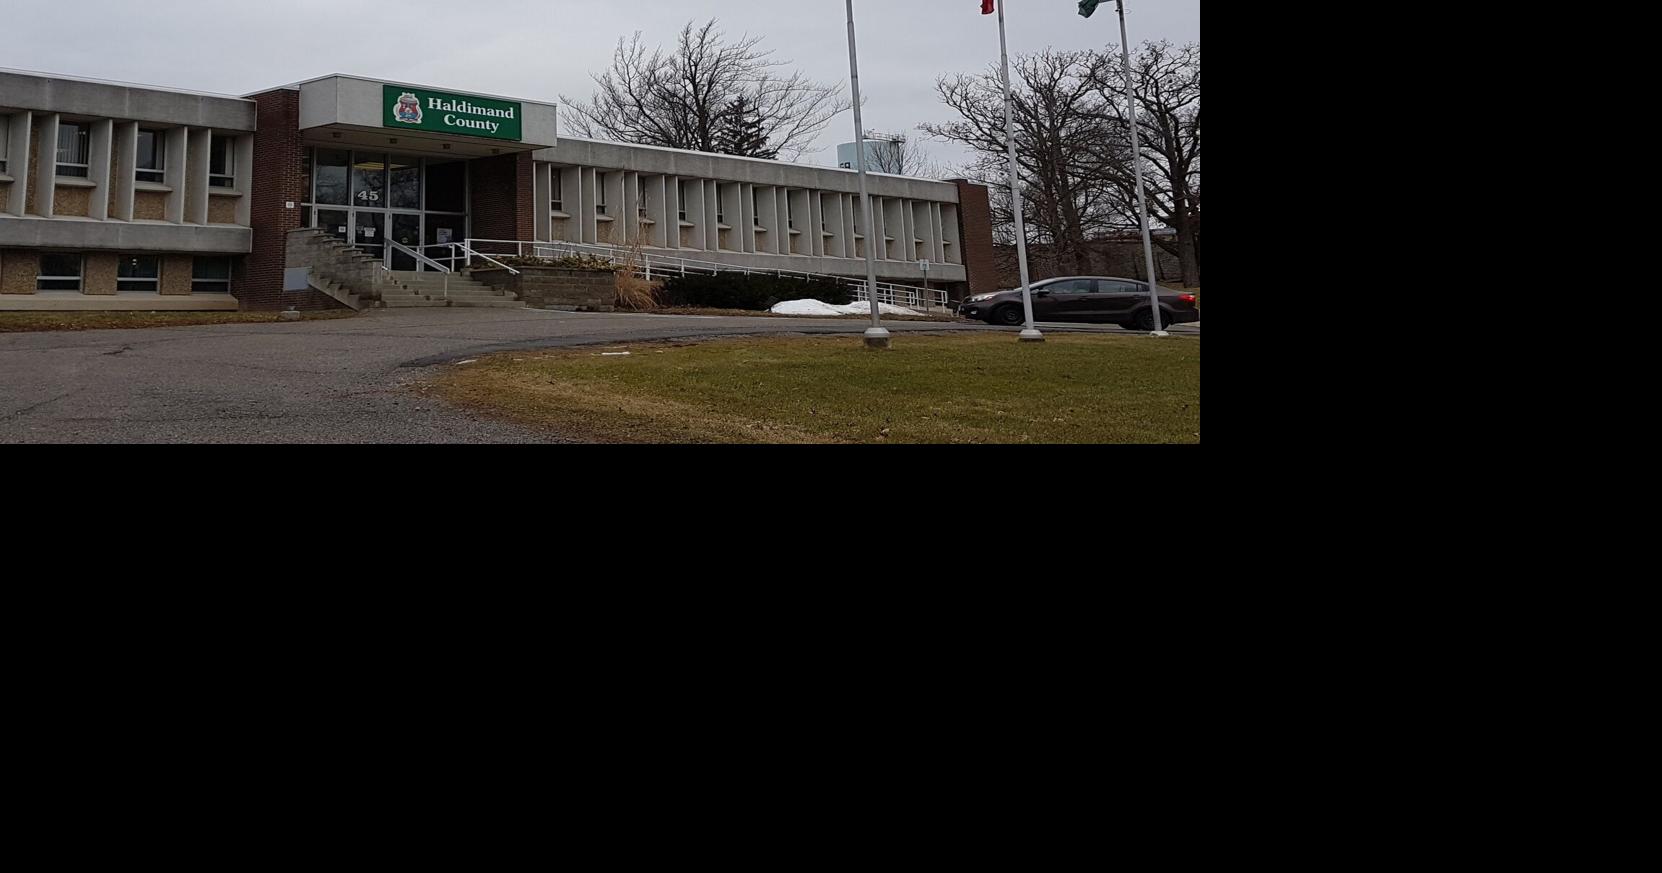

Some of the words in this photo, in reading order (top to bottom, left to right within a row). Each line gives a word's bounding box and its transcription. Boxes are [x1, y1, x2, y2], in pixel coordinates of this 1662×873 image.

[427, 97, 514, 119] Haldimand
[443, 114, 500, 133] County
[357, 190, 379, 201] 45
